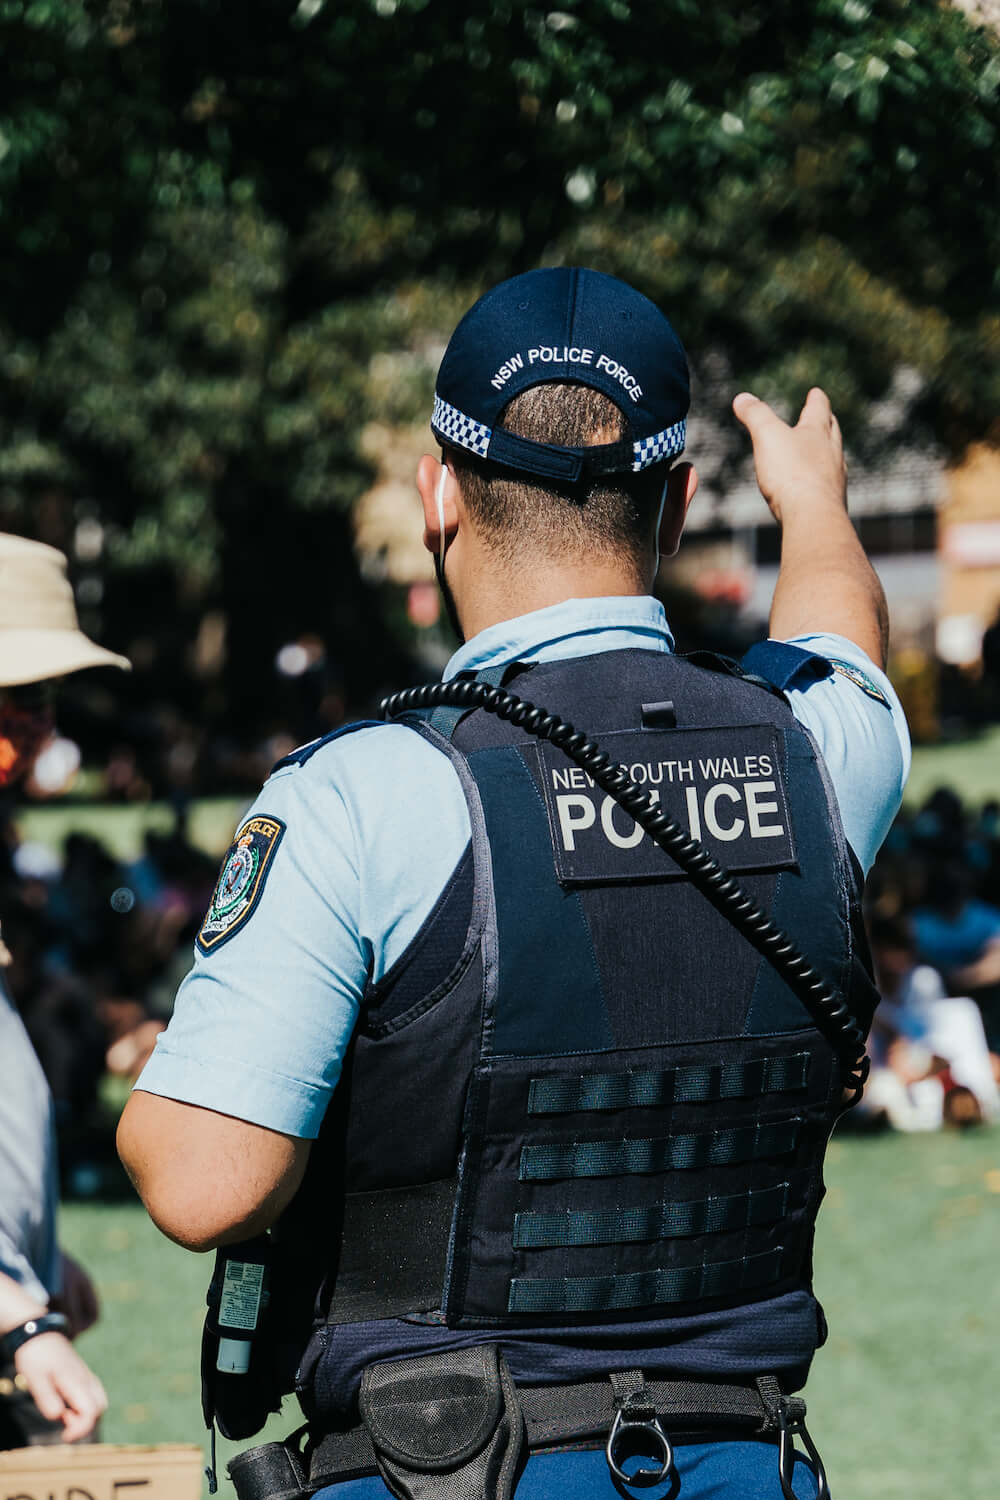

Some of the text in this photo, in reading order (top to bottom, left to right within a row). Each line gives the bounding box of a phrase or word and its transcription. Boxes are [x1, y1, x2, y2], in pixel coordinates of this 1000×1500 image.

[490, 346, 644, 403] NSW POLICE FORCE
[698, 755, 773, 781] WALES
[555, 781, 785, 852] POICE
